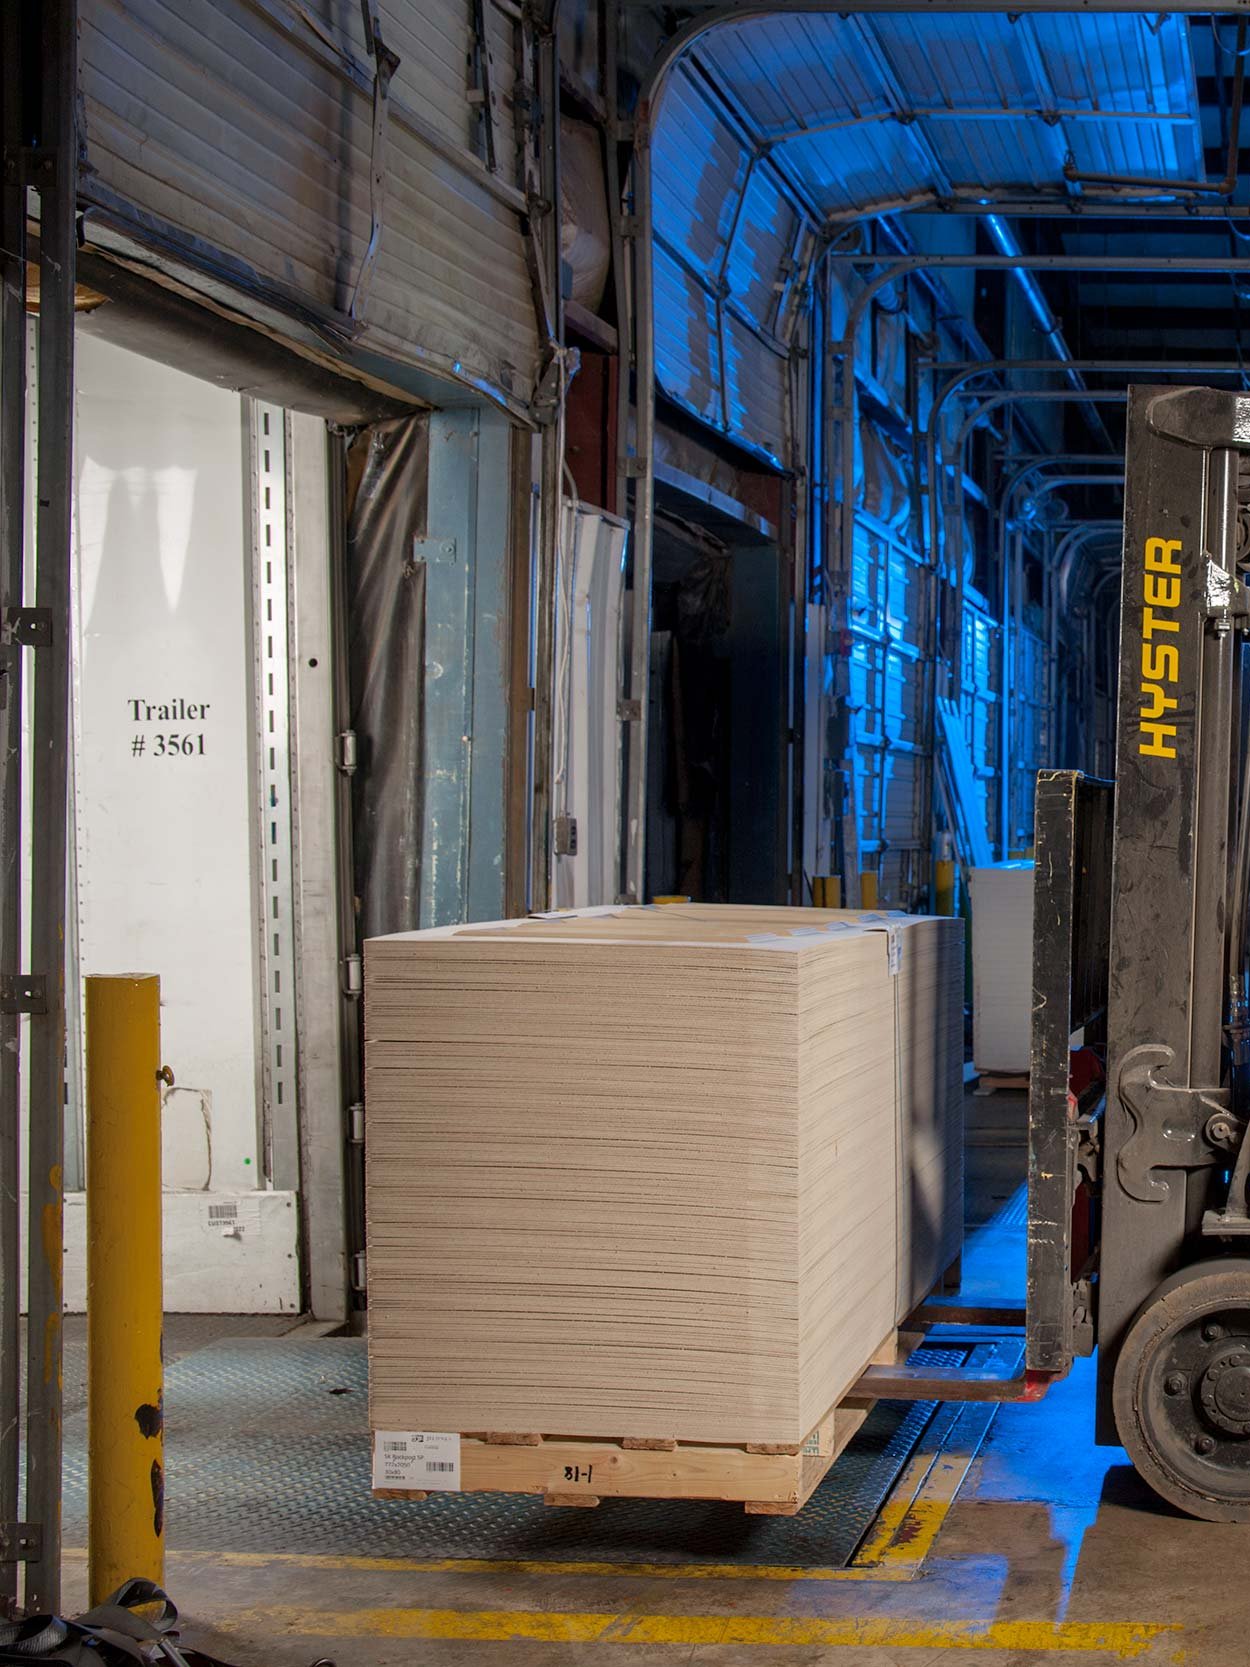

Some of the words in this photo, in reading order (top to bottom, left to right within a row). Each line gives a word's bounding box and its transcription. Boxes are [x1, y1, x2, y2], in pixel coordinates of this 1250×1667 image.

[1139, 537, 1182, 758] HYSTER
[127, 698, 210, 721] Trailer
[131, 734, 146, 757] #
[153, 733, 206, 756] 3561
